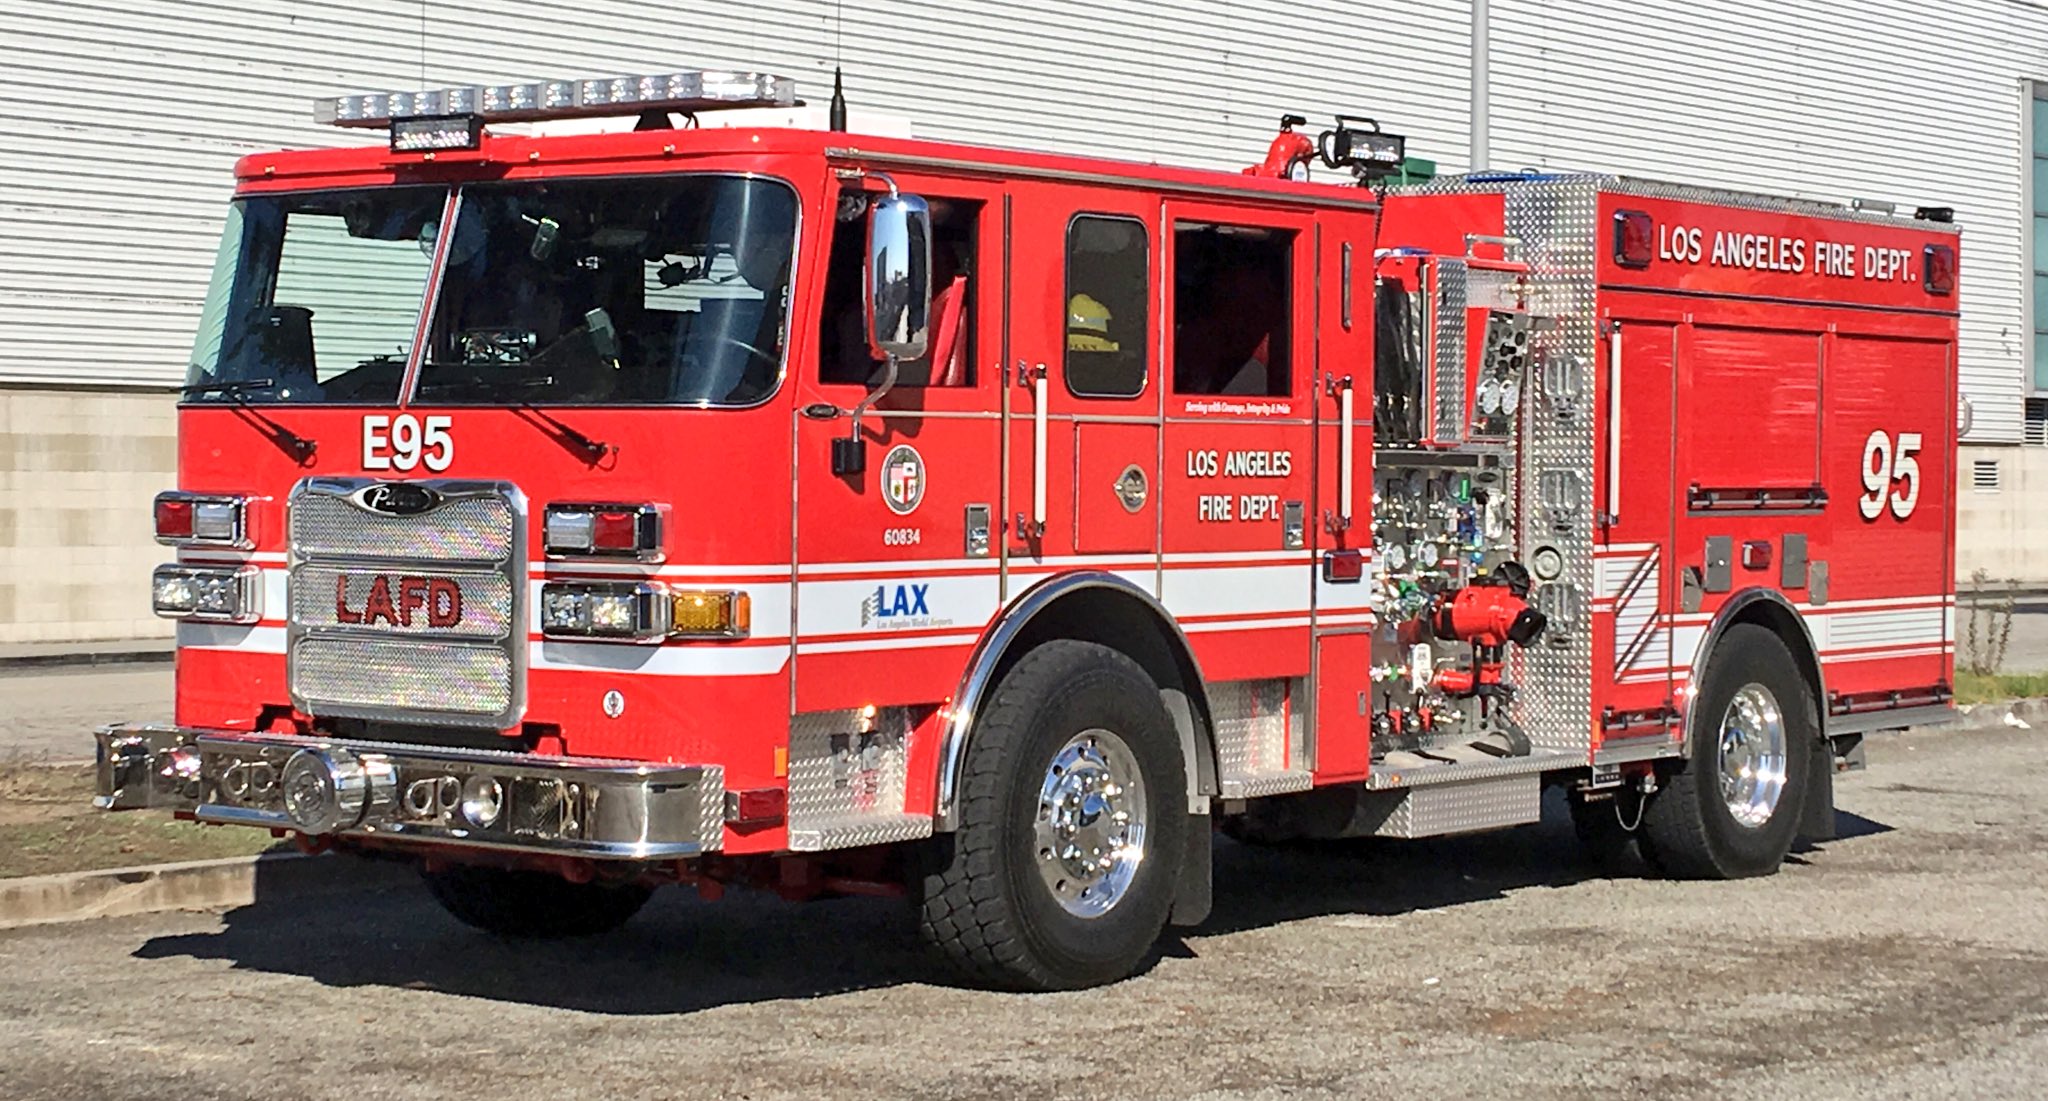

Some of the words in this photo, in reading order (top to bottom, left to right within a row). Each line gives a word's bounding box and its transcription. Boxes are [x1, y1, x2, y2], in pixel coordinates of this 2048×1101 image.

[1659, 224, 1702, 263] LOS
[1711, 230, 1806, 273] ANGELES
[1814, 241, 1856, 277] FIRE
[1864, 246, 1917, 282] DEPT.
[363, 413, 455, 472] E95
[1187, 450, 1219, 476] LOS
[1224, 450, 1292, 477] ANGELES
[1860, 429, 1923, 519] 95
[1199, 495, 1233, 521] FIRE
[1240, 495, 1280, 520] DEPT.
[884, 527, 921, 546] 60834
[336, 573, 463, 629] LAFD
[878, 583, 929, 616] LAX
